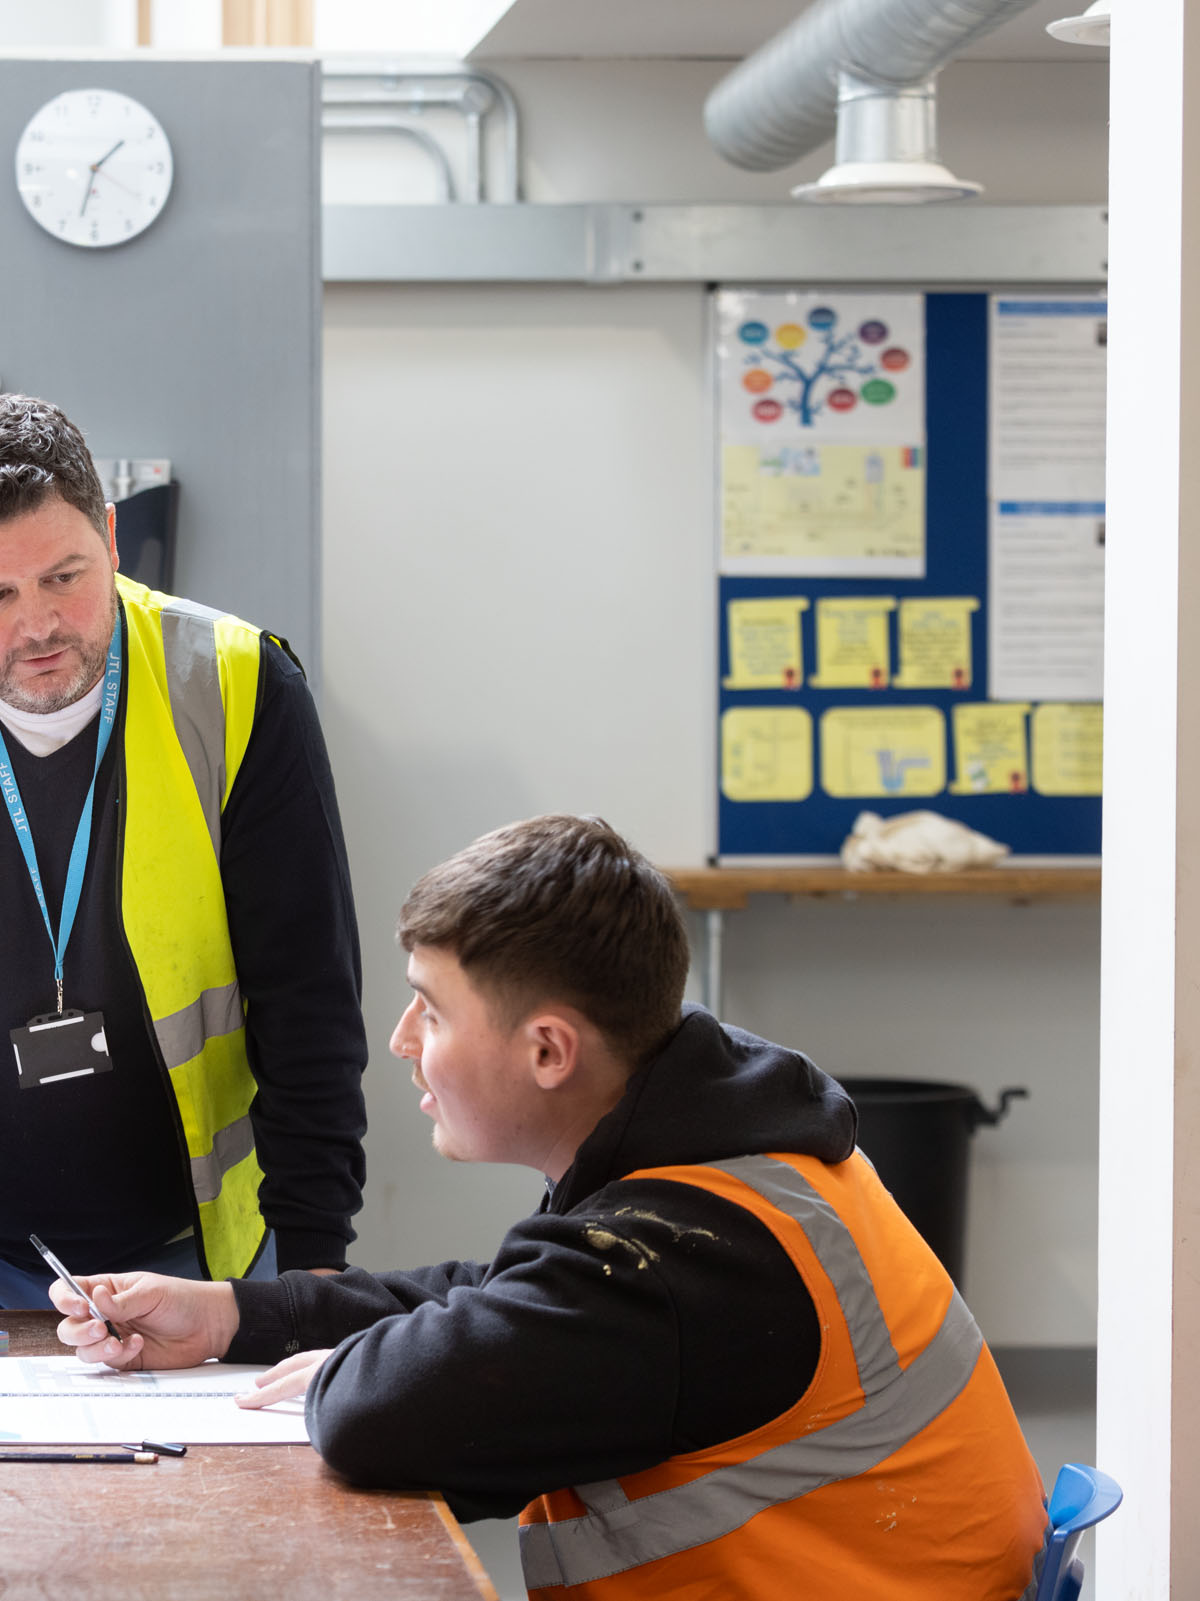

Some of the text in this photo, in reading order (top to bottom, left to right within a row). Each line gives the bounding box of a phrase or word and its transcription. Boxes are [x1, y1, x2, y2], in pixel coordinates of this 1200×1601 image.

[103, 652, 120, 725] JTL STAFF
[12, 808, 28, 833] JTL
